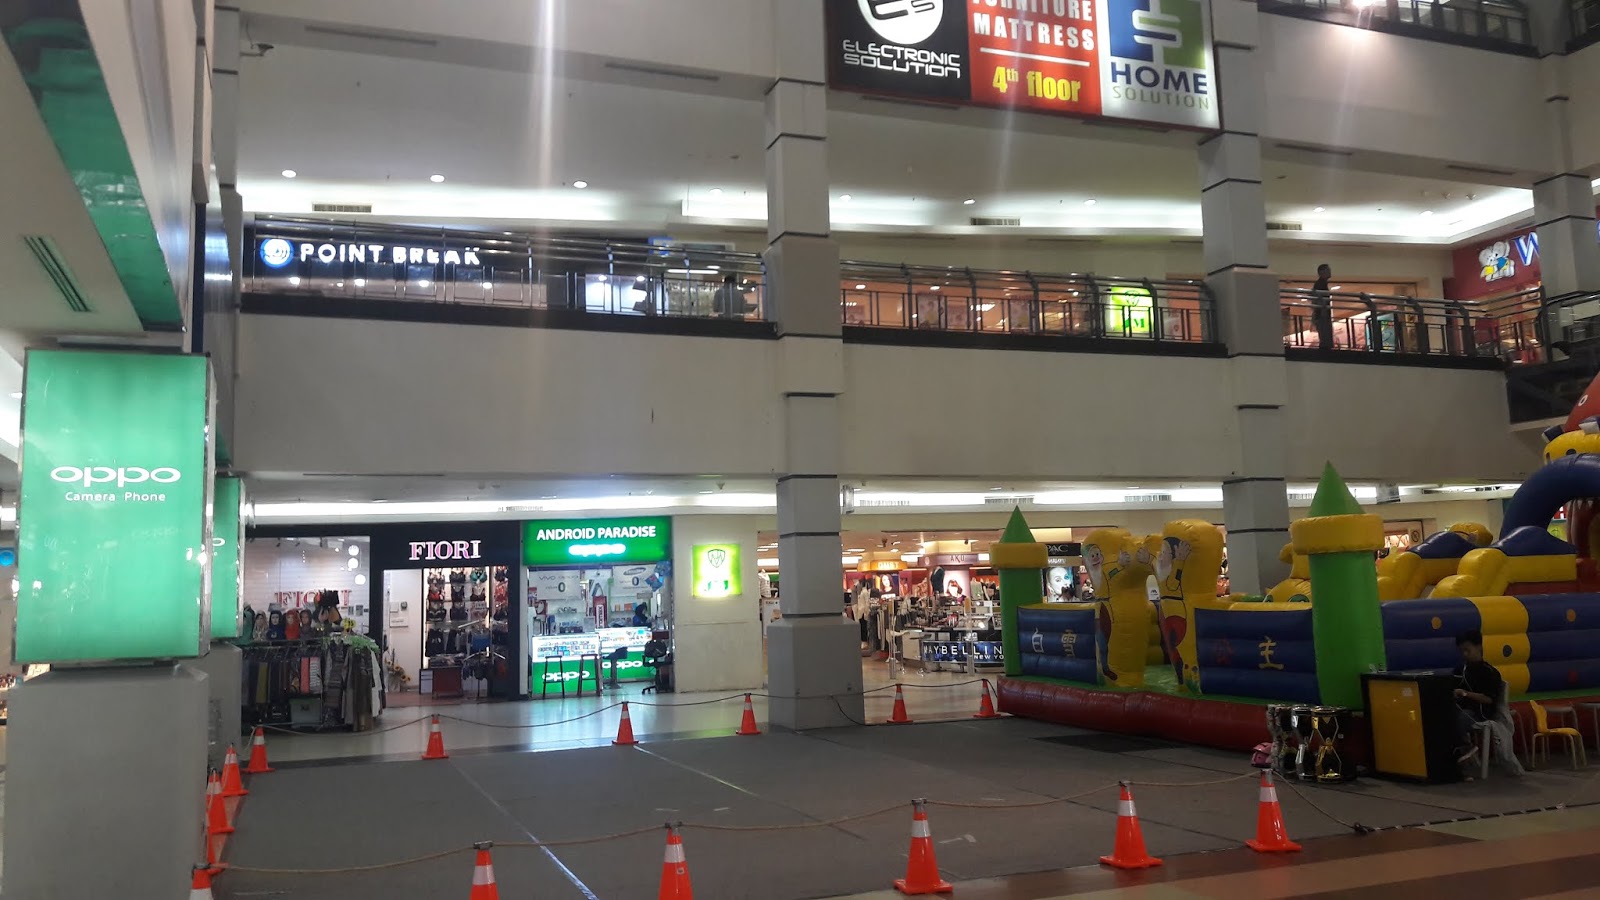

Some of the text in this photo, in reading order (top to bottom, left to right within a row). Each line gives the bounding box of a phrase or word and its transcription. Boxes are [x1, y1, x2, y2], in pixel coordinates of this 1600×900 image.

[973, 12, 1095, 51] MATTRESS
[842, 39, 961, 67] ELECTRONIC
[843, 53, 961, 79] SOLUTION
[992, 66, 1081, 103] 4th floor
[1111, 62, 1207, 95] HOME
[1112, 84, 1209, 110] SOLUTION
[300, 243, 481, 265] POINT BREAK
[50, 466, 182, 488] oppo
[65, 491, 166, 502] Camera Phone
[536, 525, 656, 541] ANDROID PARADISE
[408, 540, 482, 561] FIORI
[274, 588, 353, 608] FIOI
[923, 645, 1003, 655] MAYBELLIN
